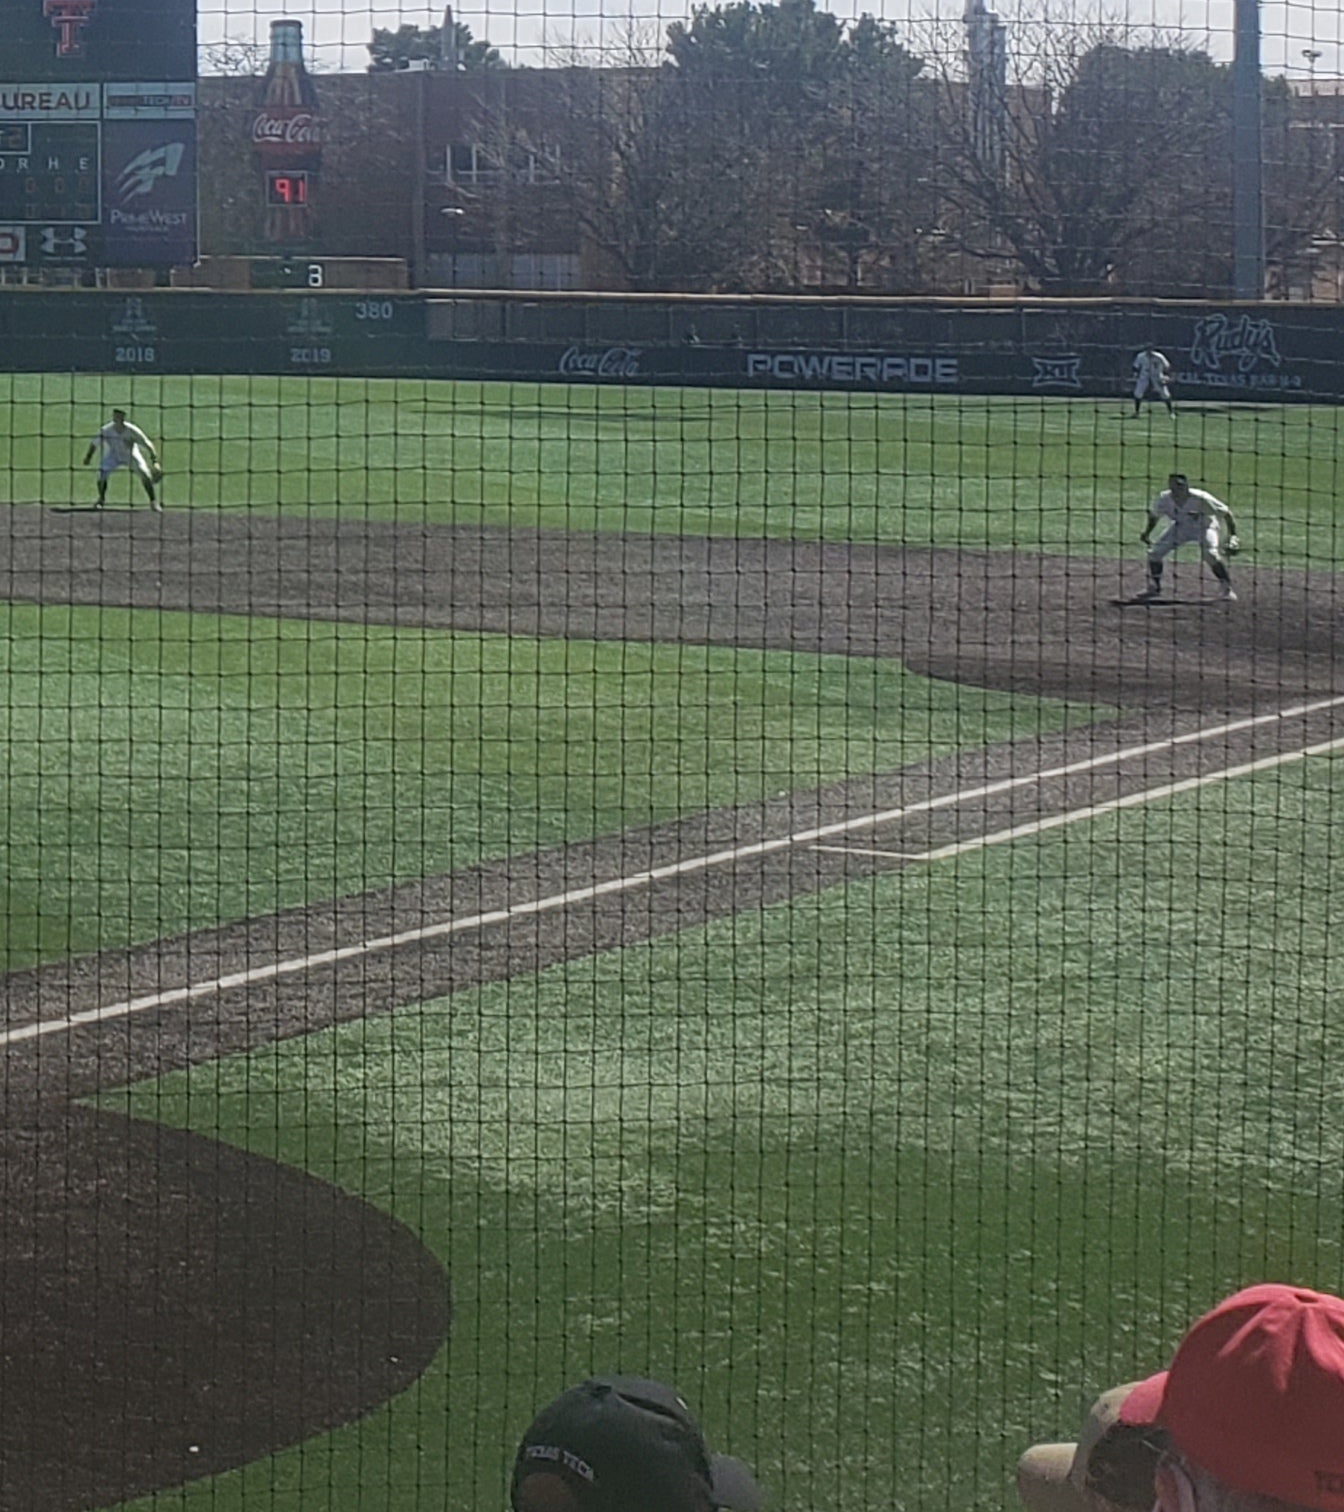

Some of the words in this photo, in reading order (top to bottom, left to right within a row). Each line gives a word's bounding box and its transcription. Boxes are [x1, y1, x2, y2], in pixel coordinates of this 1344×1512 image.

[17, 157, 29, 170] R
[48, 157, 59, 170] H
[79, 157, 89, 170] E
[275, 178, 305, 203] 91
[356, 302, 393, 319] 380
[1190, 312, 1281, 372] Rudy's
[115, 347, 155, 363] 2018
[290, 347, 332, 364] 2019
[747, 353, 959, 383] POWERADE
[563, 1450, 594, 1483] TECH
